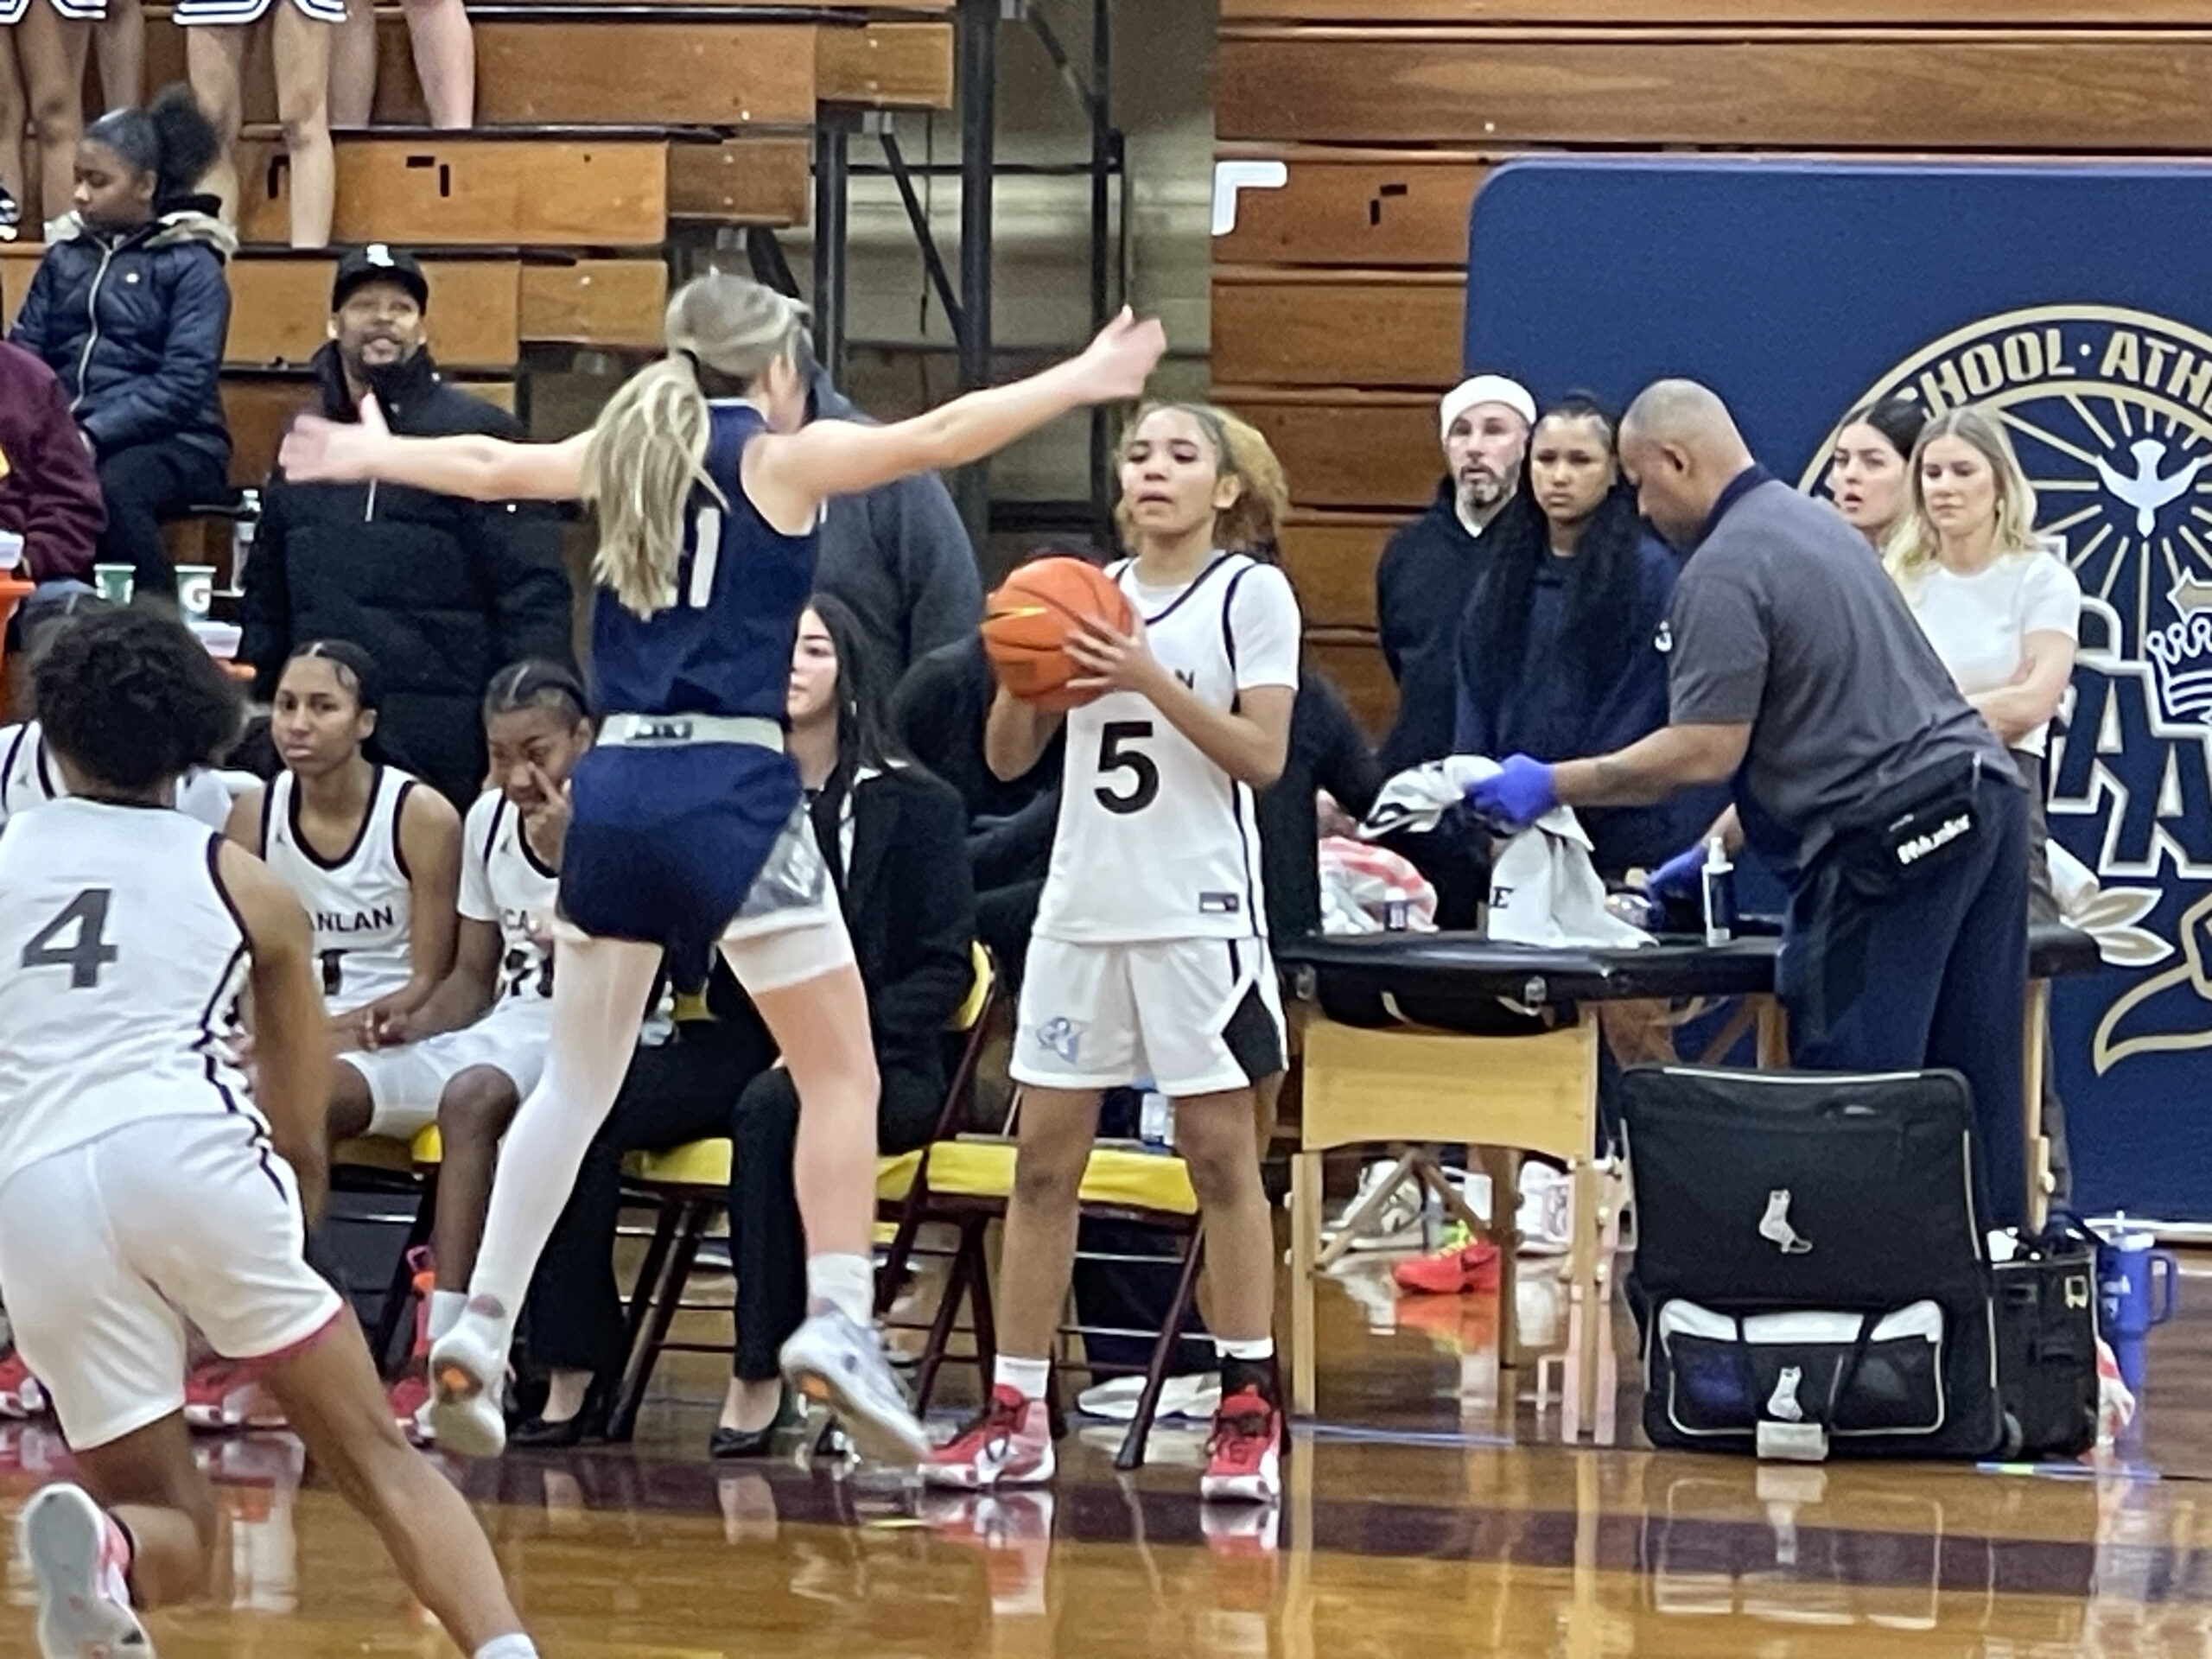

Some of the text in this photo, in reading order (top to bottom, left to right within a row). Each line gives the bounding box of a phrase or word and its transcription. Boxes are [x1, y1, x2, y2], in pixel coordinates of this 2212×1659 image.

[1895, 328, 2212, 421] HOOL ATH
[1094, 721, 1160, 815] 5
[22, 887, 118, 988] 4
